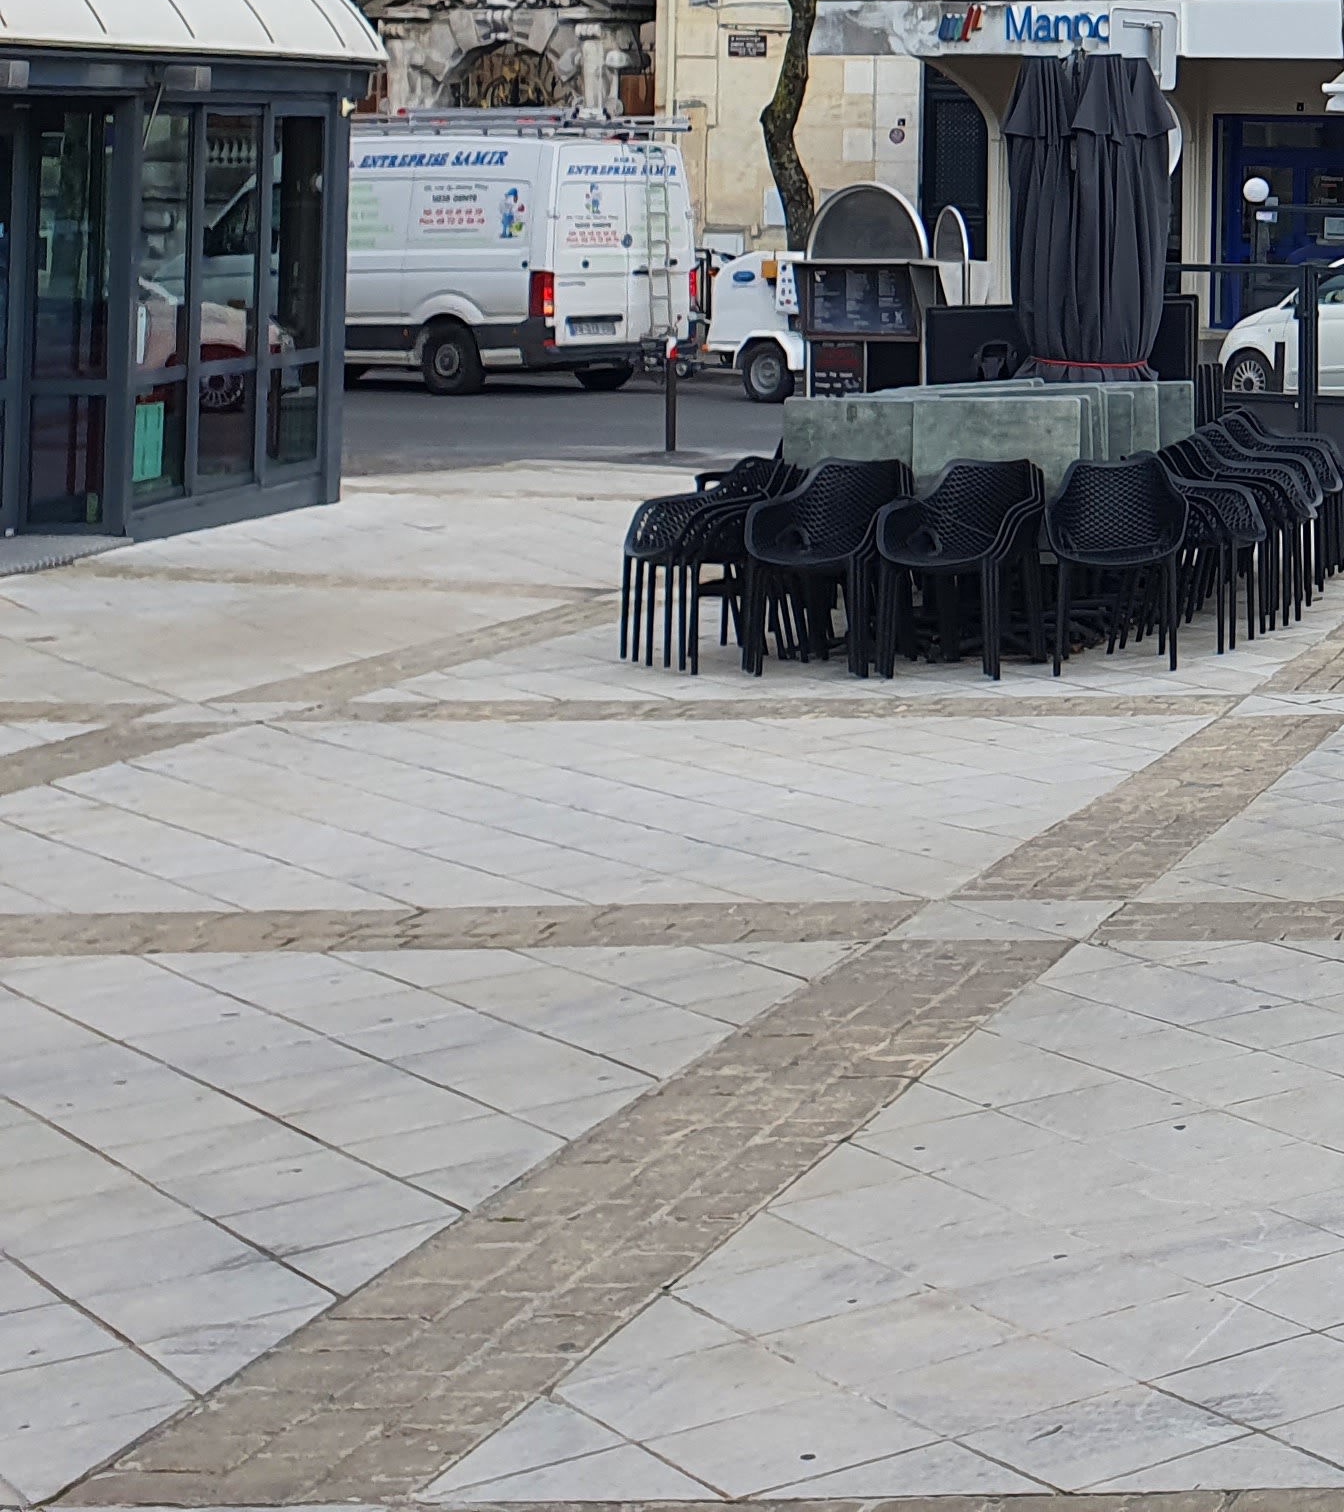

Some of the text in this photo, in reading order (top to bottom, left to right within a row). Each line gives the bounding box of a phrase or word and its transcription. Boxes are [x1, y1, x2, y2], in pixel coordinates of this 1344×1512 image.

[359, 150, 509, 168] ENTREPRISE SAMIR
[567, 165, 637, 176] ENTREPRISE
